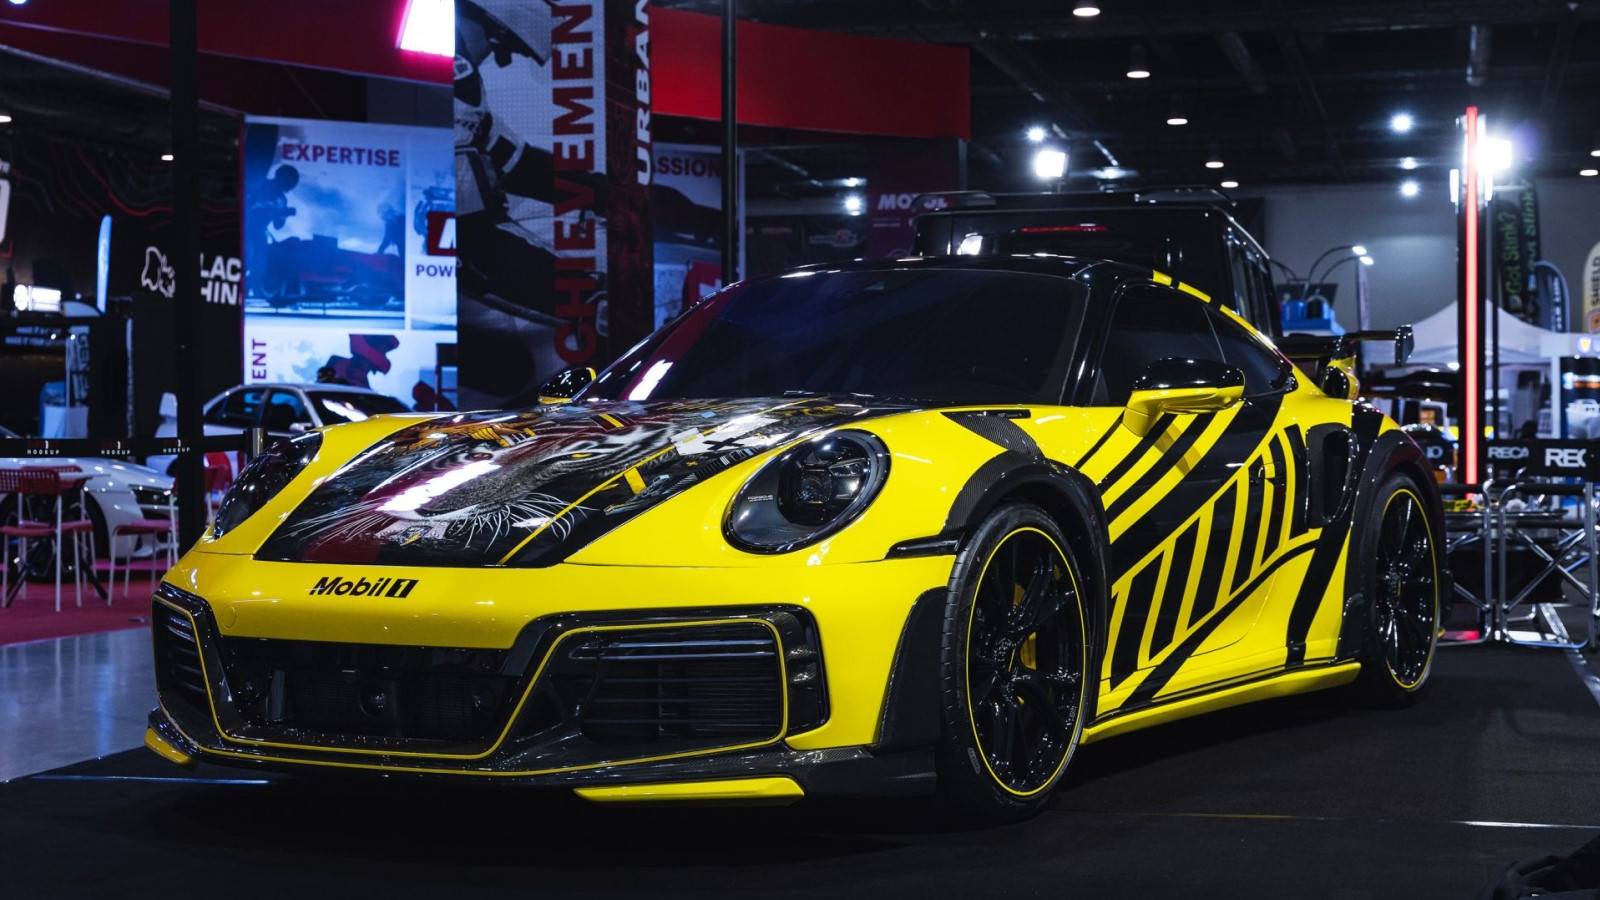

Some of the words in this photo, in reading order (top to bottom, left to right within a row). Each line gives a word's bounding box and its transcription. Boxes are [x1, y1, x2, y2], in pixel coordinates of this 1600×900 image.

[281, 143, 399, 167] EXPERTISE
[416, 264, 453, 278] POW
[200, 279, 242, 306] HIN
[308, 576, 392, 596] Mobil
[386, 578, 417, 598] 1
